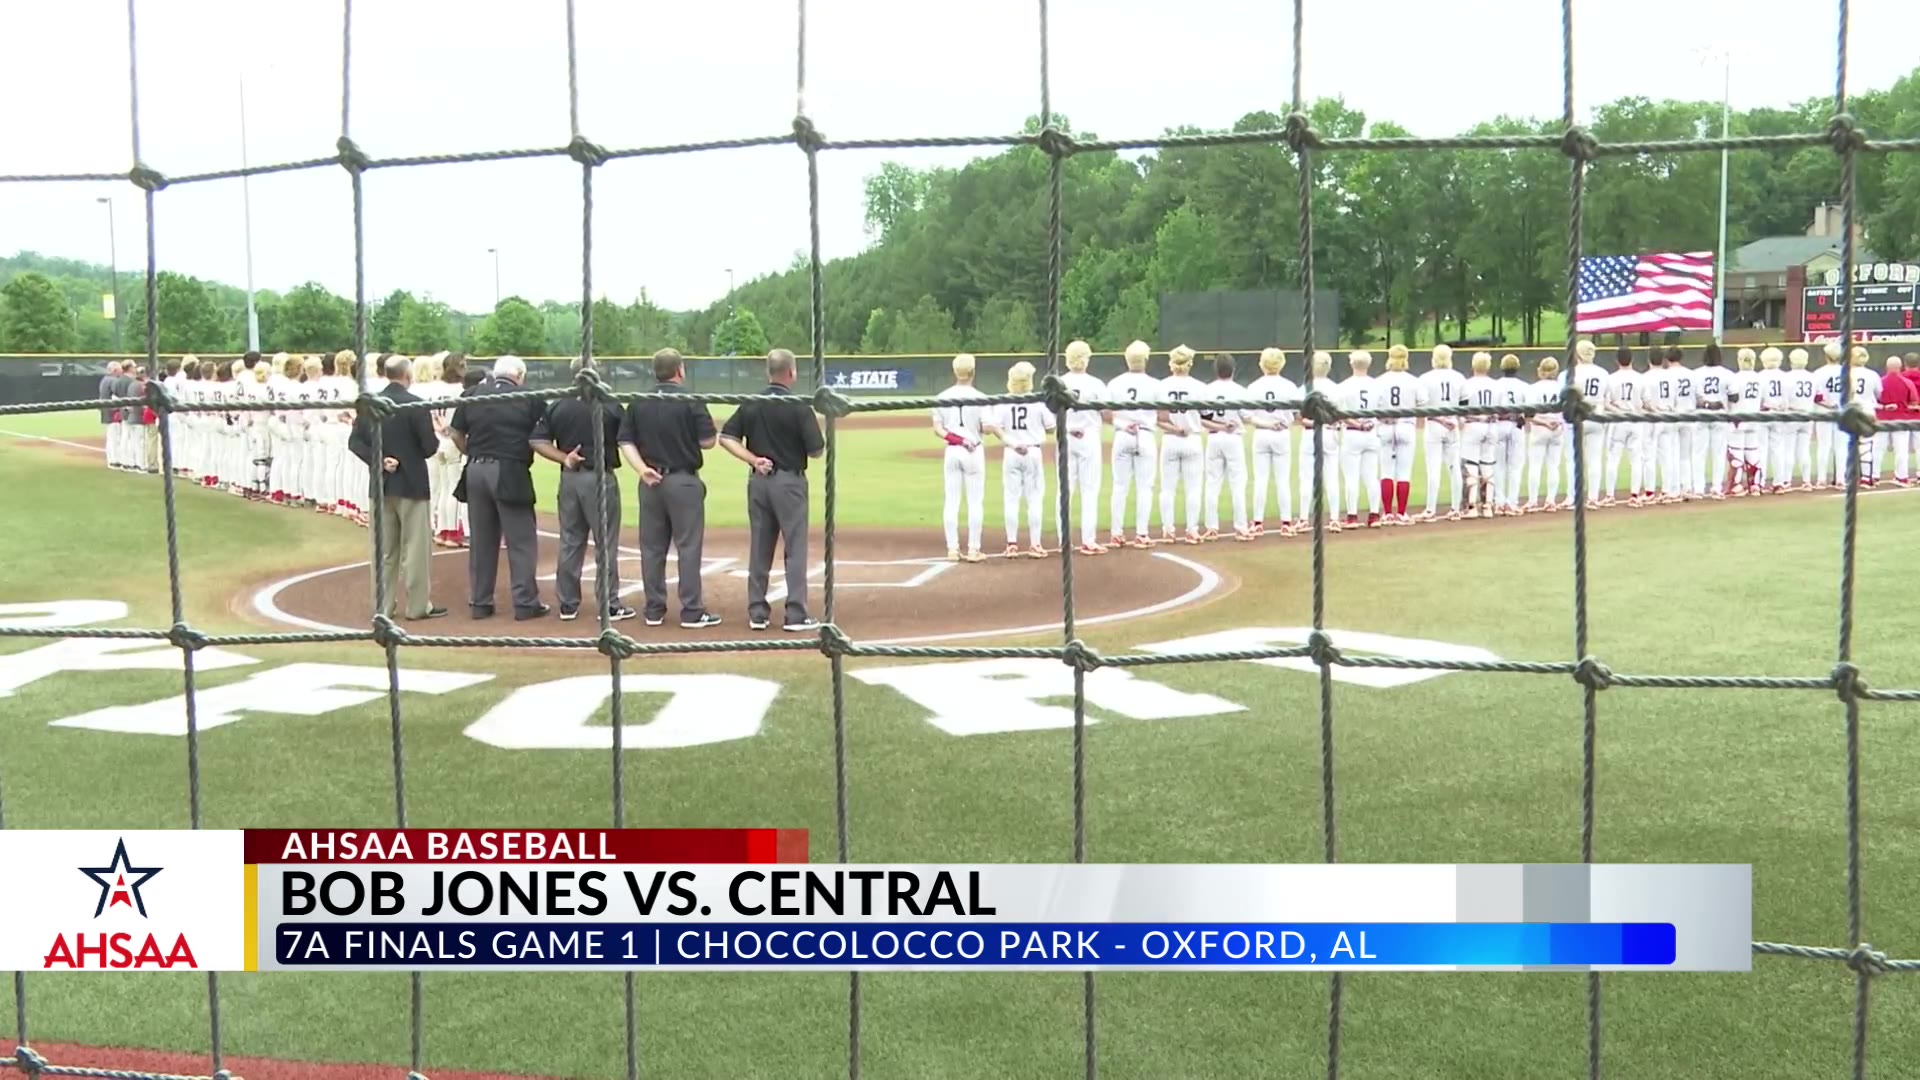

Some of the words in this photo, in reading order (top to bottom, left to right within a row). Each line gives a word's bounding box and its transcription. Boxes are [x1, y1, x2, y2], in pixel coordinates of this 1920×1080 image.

[850, 371, 898, 385] STATE
[1584, 378, 1600, 396] 16
[1704, 376, 1720, 395] 23
[1390, 386, 1401, 407] 8
[1440, 382, 1451, 401] 11
[1621, 382, 1633, 401] 17
[1769, 380, 1782, 398] 31
[1796, 380, 1813, 398] 33
[1360, 390, 1369, 409] 5
[1011, 406, 1027, 430] 12
